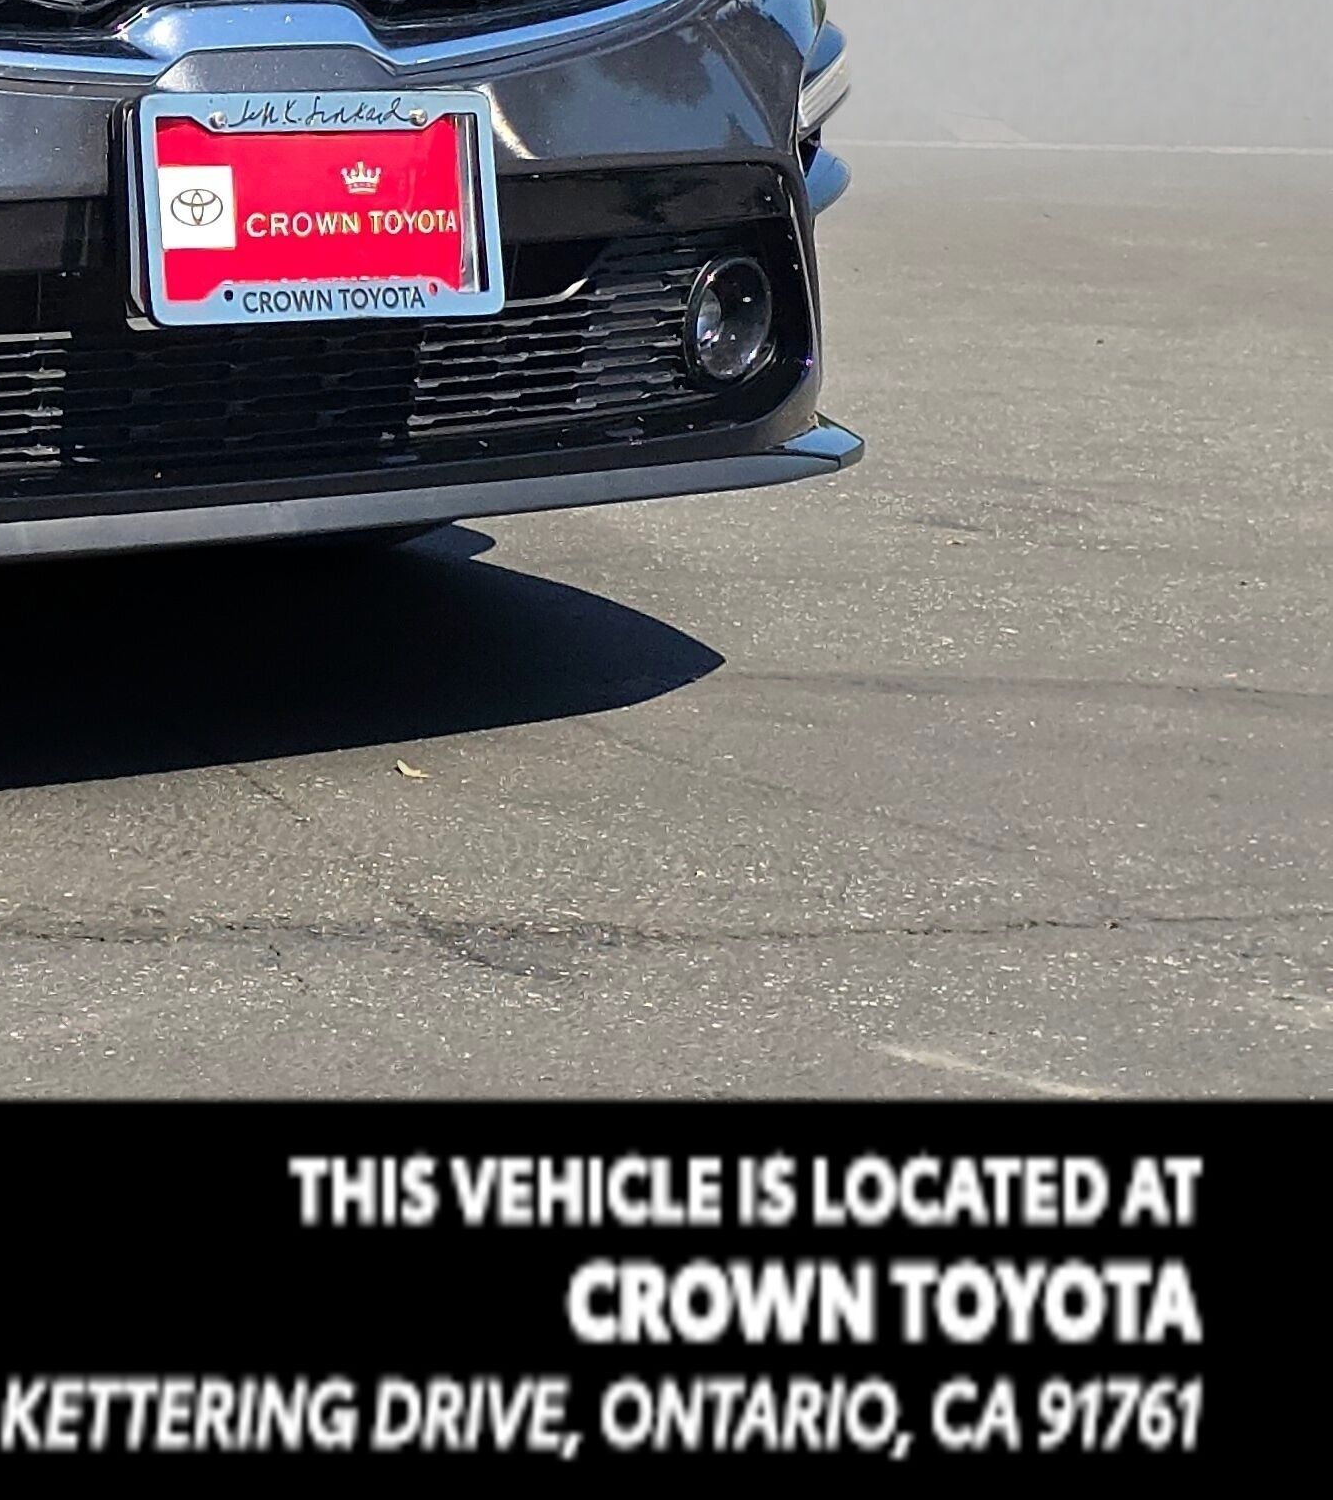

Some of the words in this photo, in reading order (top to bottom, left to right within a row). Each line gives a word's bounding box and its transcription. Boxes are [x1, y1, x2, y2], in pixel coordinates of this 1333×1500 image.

[245, 212, 359, 239] CROWN
[370, 209, 458, 235] TOYOTA
[242, 288, 334, 315] CROWN
[338, 285, 426, 310] TOYOTA
